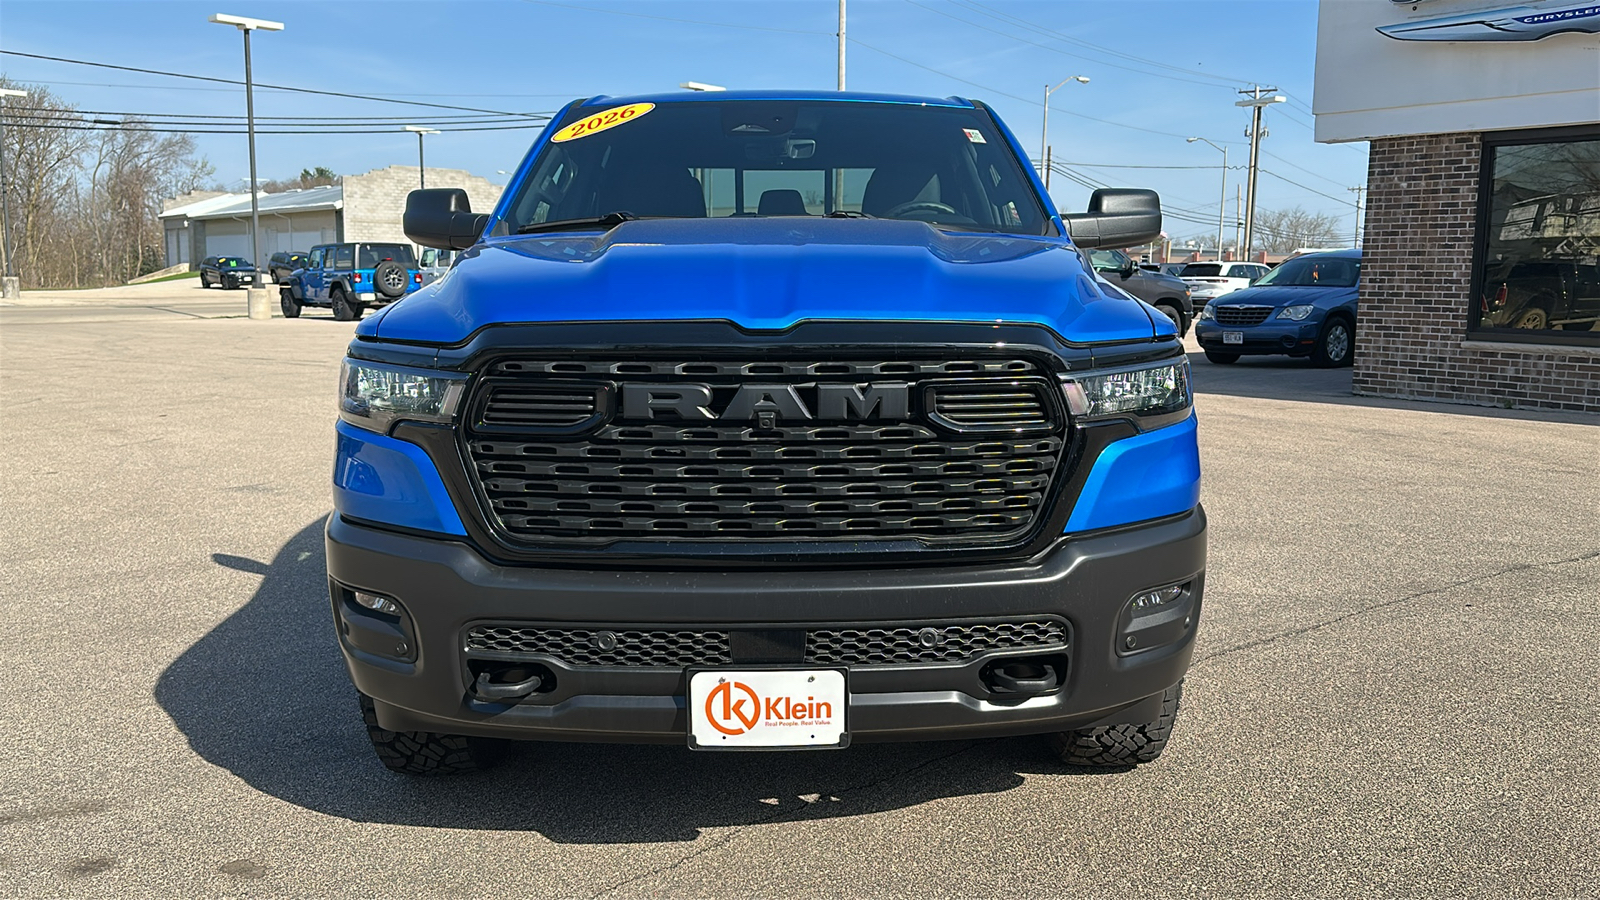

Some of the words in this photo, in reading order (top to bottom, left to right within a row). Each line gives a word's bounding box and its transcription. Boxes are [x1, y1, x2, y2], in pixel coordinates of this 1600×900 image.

[571, 105, 636, 138] 2026
[622, 382, 910, 420] RAM
[765, 696, 832, 720] Klein
